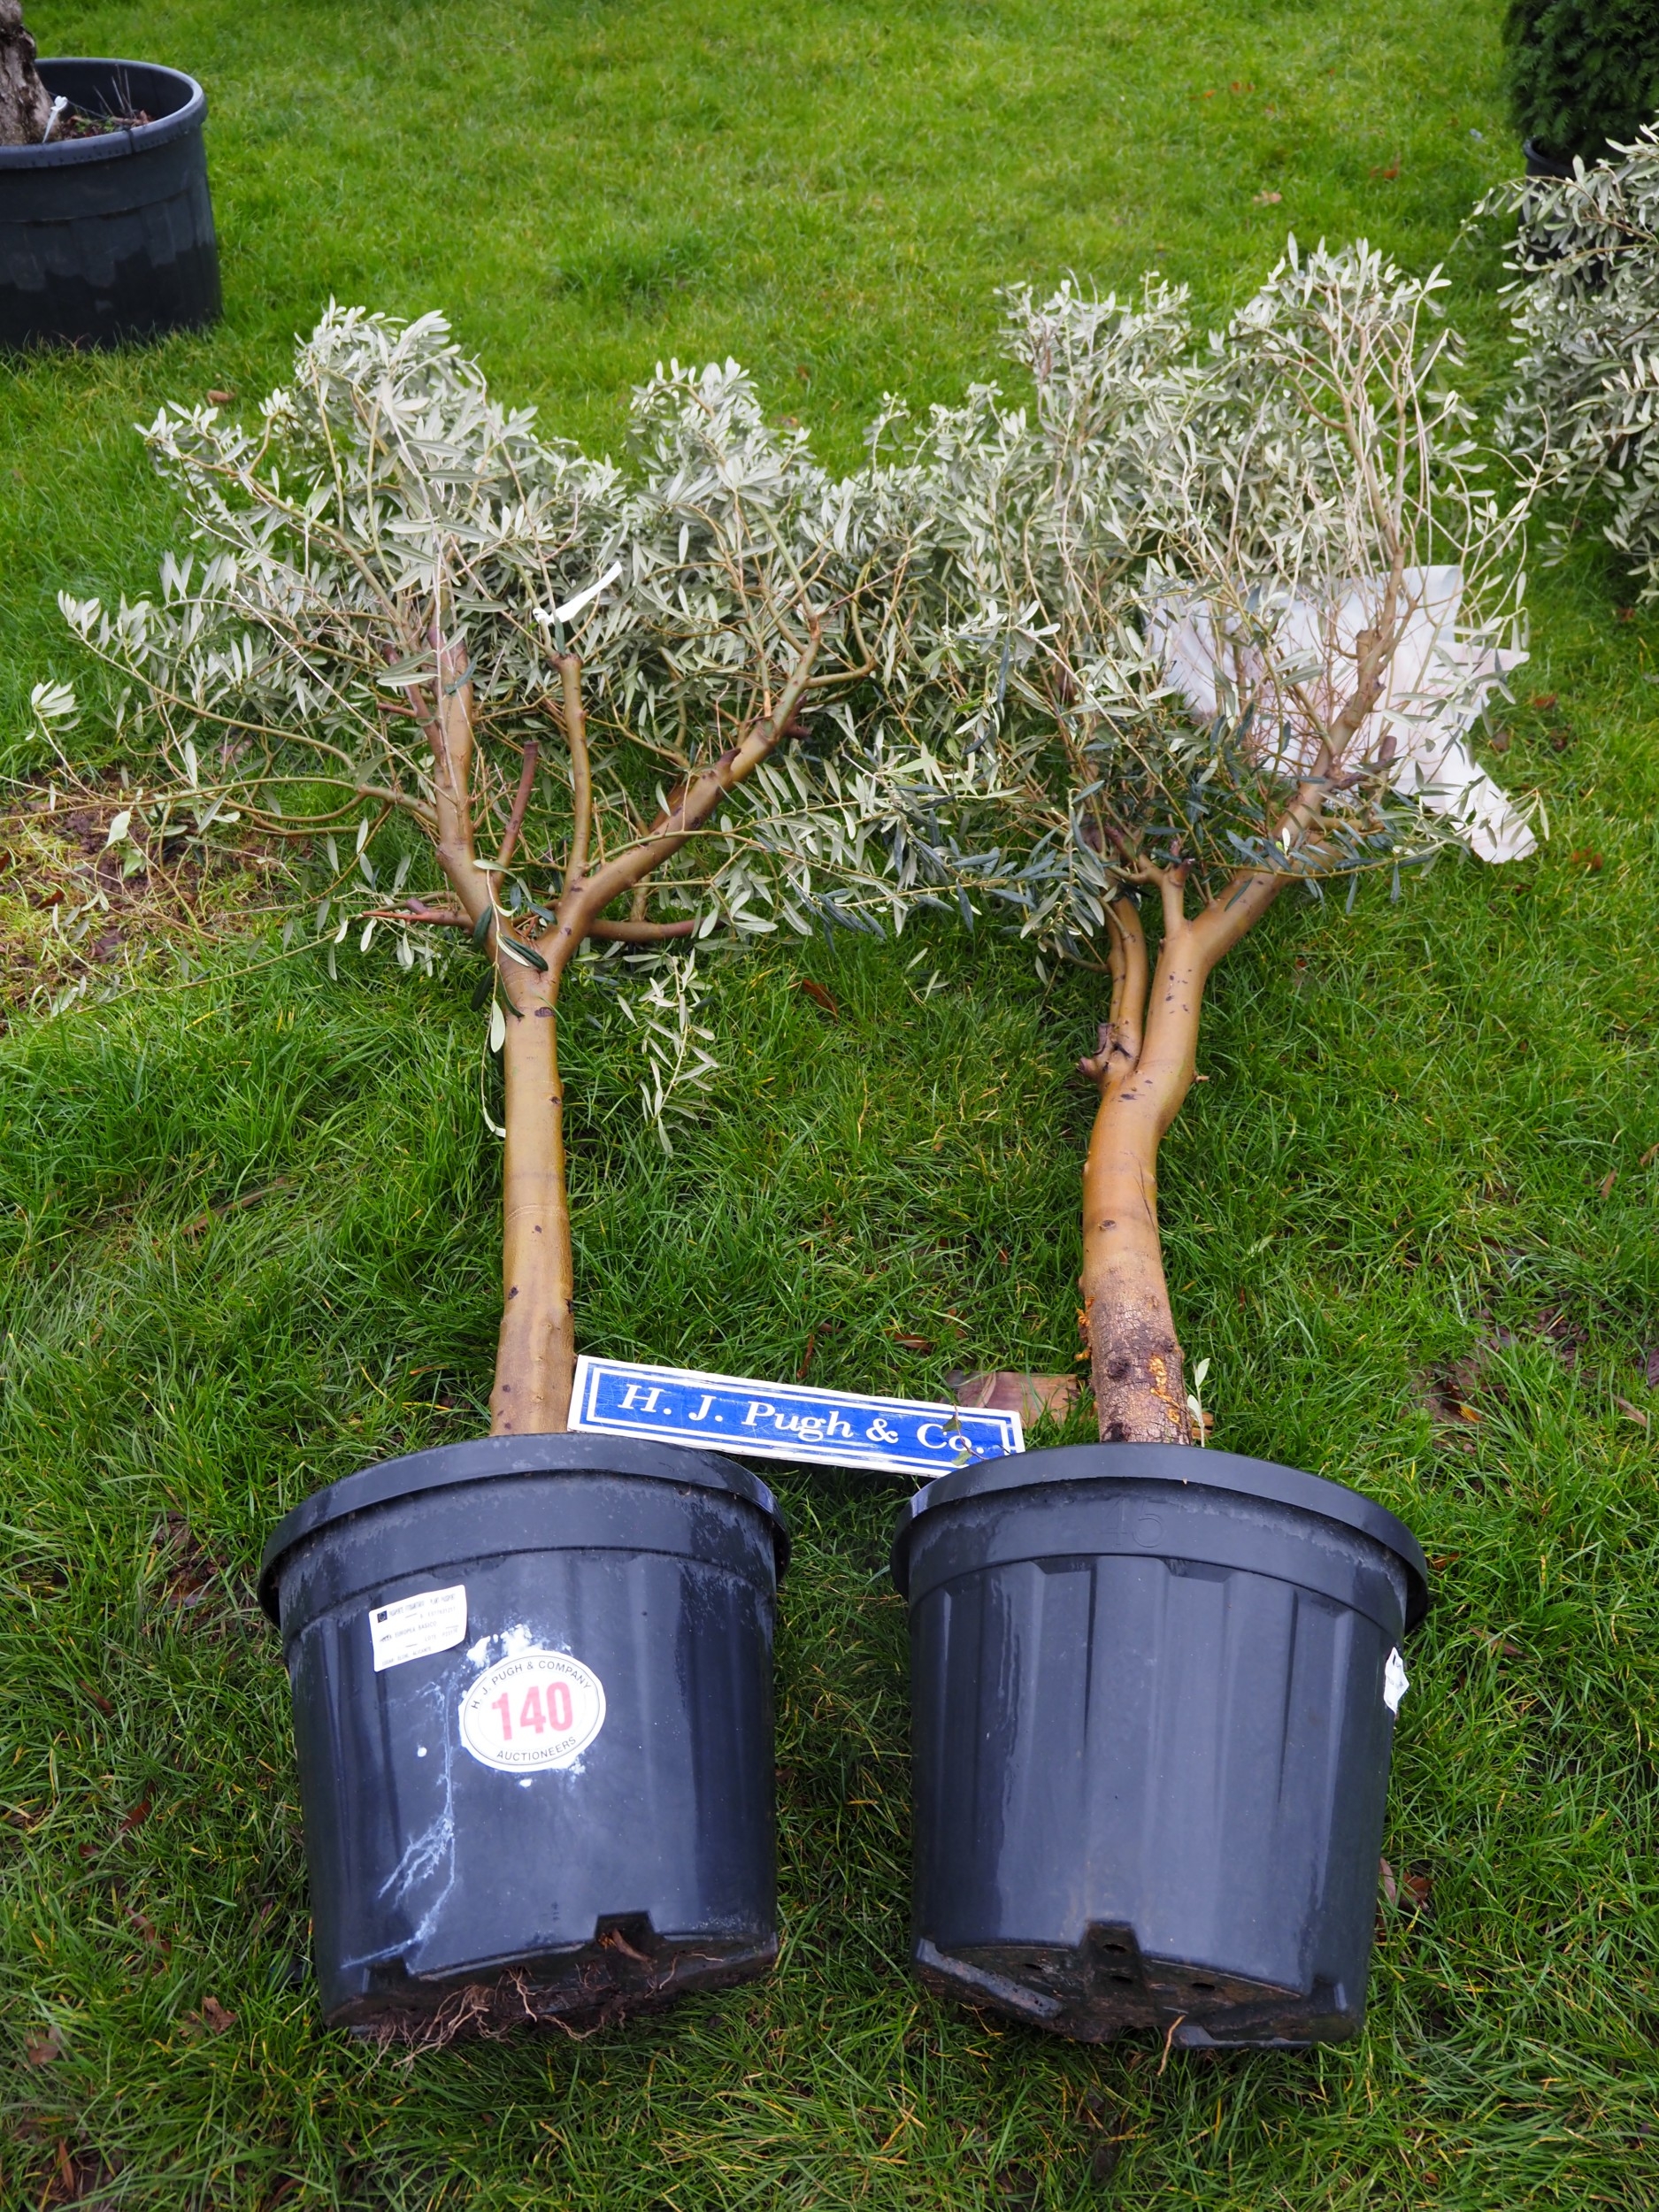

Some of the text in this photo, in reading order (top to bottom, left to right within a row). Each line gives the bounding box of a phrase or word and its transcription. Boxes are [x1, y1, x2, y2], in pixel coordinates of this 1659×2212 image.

[618, 1383, 985, 1455] H. J. Pugh & Co.
[471, 1660, 592, 1709] H. J. PUGH & COMPANY
[491, 1681, 573, 1741] 140
[496, 1736, 576, 1762] AUCTIONEERS
